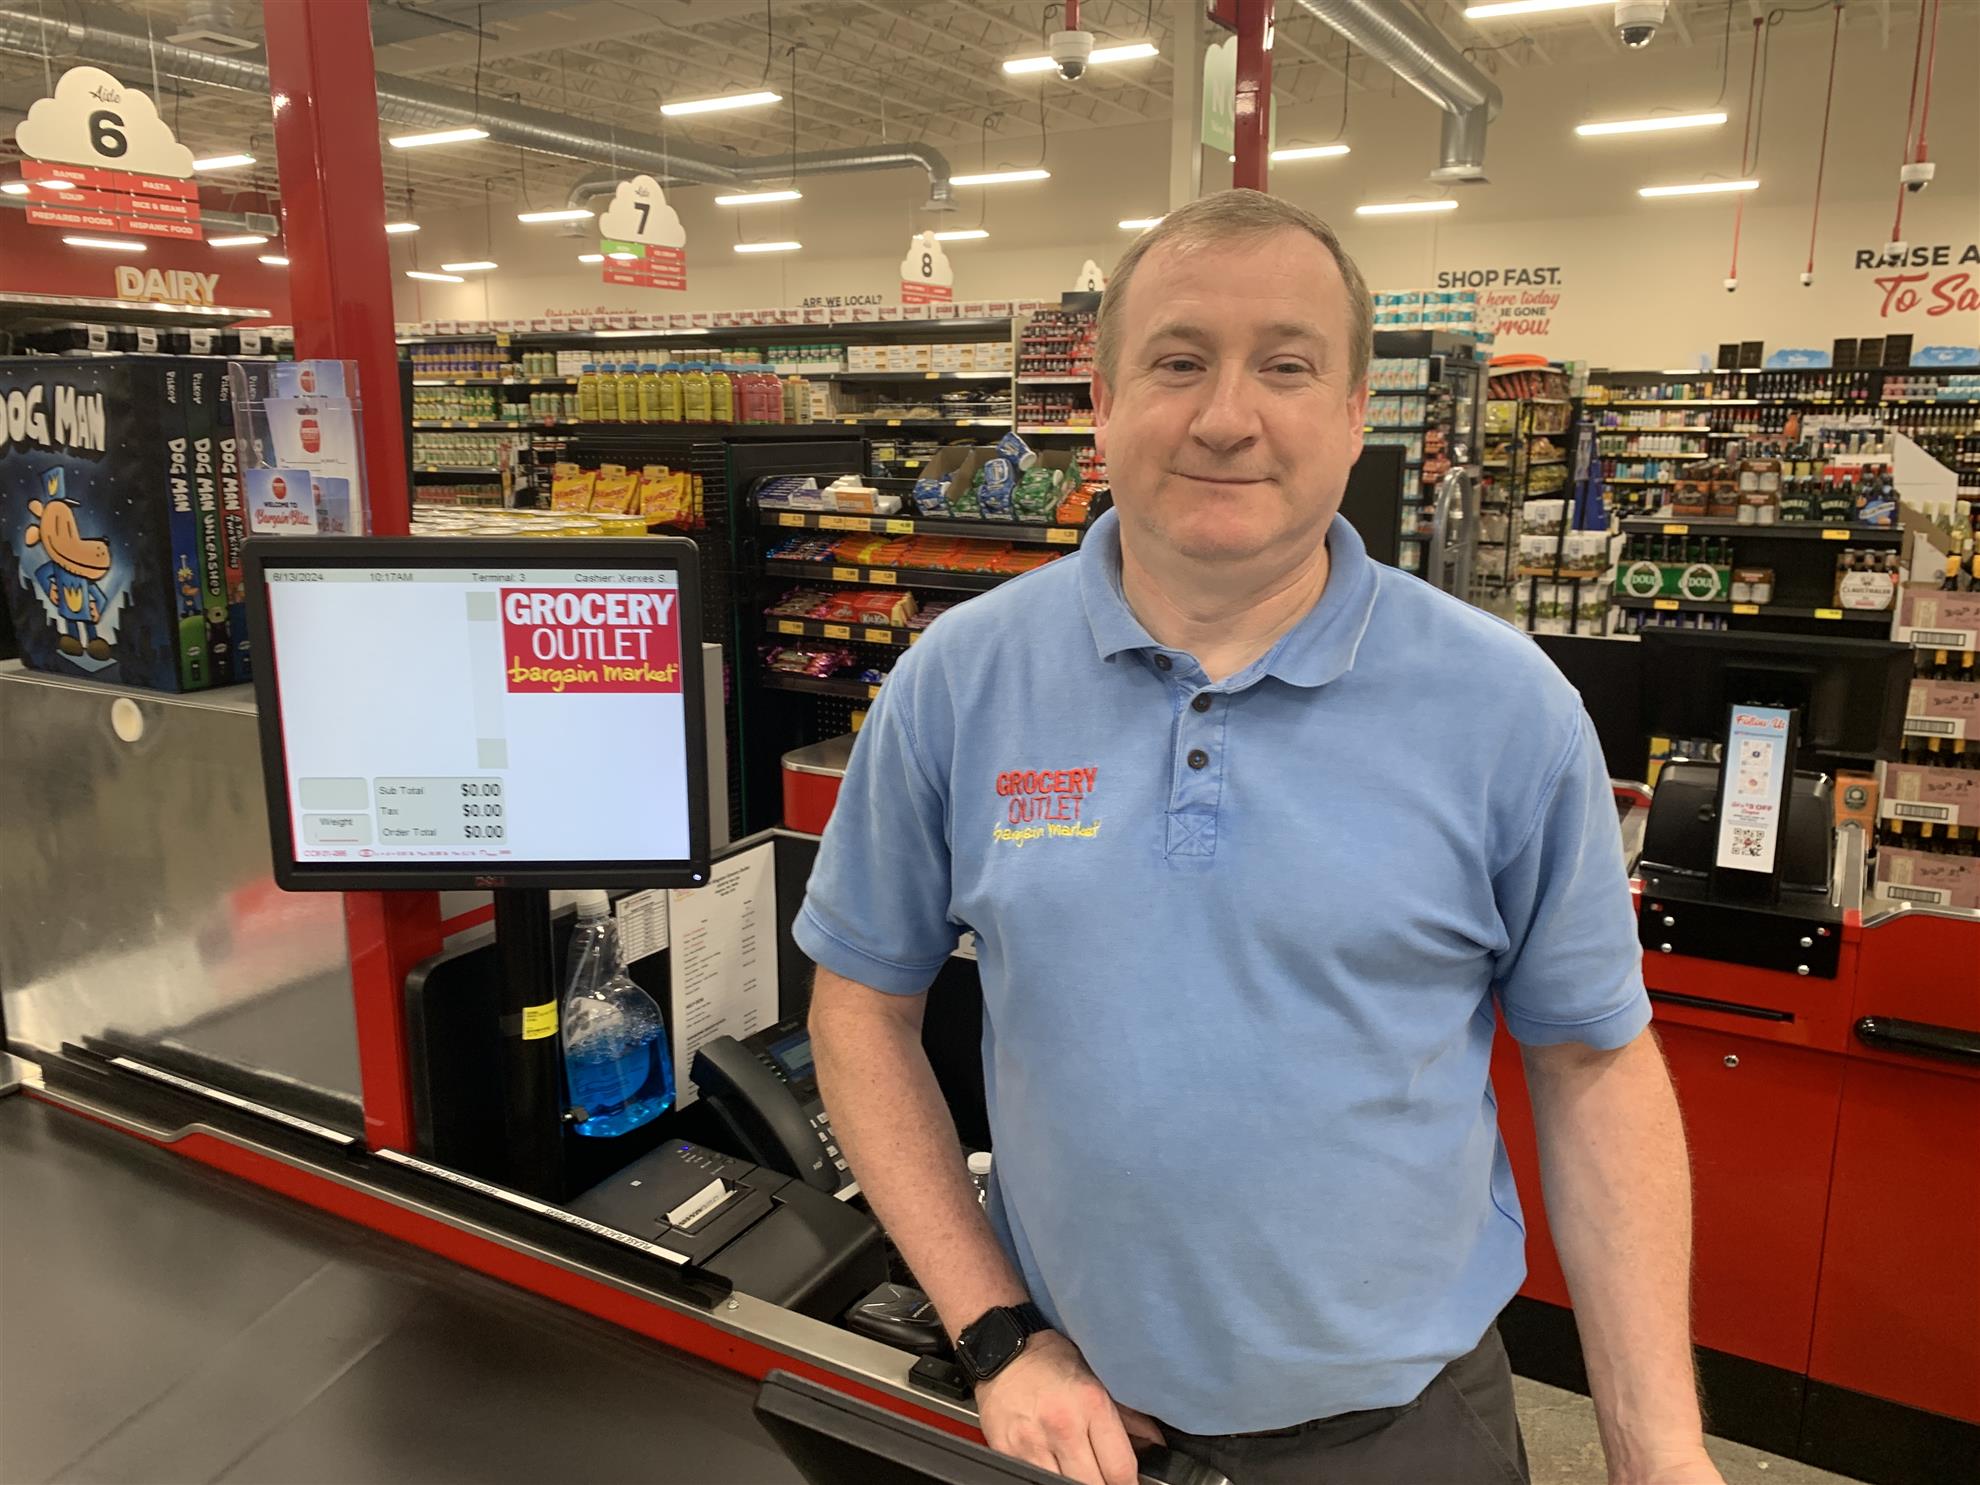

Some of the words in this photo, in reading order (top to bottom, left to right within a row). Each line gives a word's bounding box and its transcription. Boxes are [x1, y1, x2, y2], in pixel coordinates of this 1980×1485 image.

[89, 110, 127, 158] 6
[142, 180, 172, 192] PASTA
[32, 210, 81, 223] PREPARED
[82, 215, 114, 226] FOODS
[129, 221, 169, 232] HISPANIC
[170, 224, 194, 234] FOOD
[634, 202, 650, 235] 7
[922, 252, 932, 278] 8
[1438, 270, 1499, 288] SHOP
[1504, 267, 1562, 286] FAST.
[115, 265, 220, 304] DAIRY
[1486, 290, 1517, 306] here
[1520, 289, 1561, 309] today
[1874, 272, 1922, 318] To
[803, 297, 822, 307] ARE
[826, 296, 841, 307] WE
[845, 294, 883, 306] LOCAL?
[1514, 306, 1547, 317] GONE
[55, 385, 106, 452] MAN
[168, 437, 187, 474] DOG
[193, 437, 213, 474] DOG
[219, 438, 238, 475] DOG
[170, 477, 192, 513] MAN
[196, 477, 216, 512] MAN
[222, 477, 241, 512] MAN
[264, 501, 290, 509] WELCOME
[273, 572, 324, 582] 6/13/2024
[370, 572, 413, 582] 10:17AM
[471, 573, 514, 581] Terminal:
[519, 573, 526, 581] 3
[575, 573, 614, 582] Cashier:
[618, 574, 654, 583] Xerxes
[658, 574, 667, 583] S.
[504, 592, 676, 626] GROCERY
[532, 628, 653, 661] OUTLET
[508, 655, 599, 692] bargain
[603, 662, 677, 683] market
[1736, 714, 1767, 728] Follow
[379, 786, 397, 796] Sub
[400, 786, 424, 796] Total
[461, 783, 500, 797] $0.00
[996, 767, 1098, 796] GROCERY
[319, 817, 353, 828] Weight
[381, 806, 399, 816] Tax
[462, 804, 502, 818] $0.00
[1008, 795, 1084, 824] OUTLET
[382, 828, 410, 837] Order
[413, 828, 437, 837] Total
[464, 825, 504, 839] $0.00
[993, 822, 1044, 848] bargain
[1047, 819, 1101, 838] market
[626, 1235, 653, 1250] PLEASE
